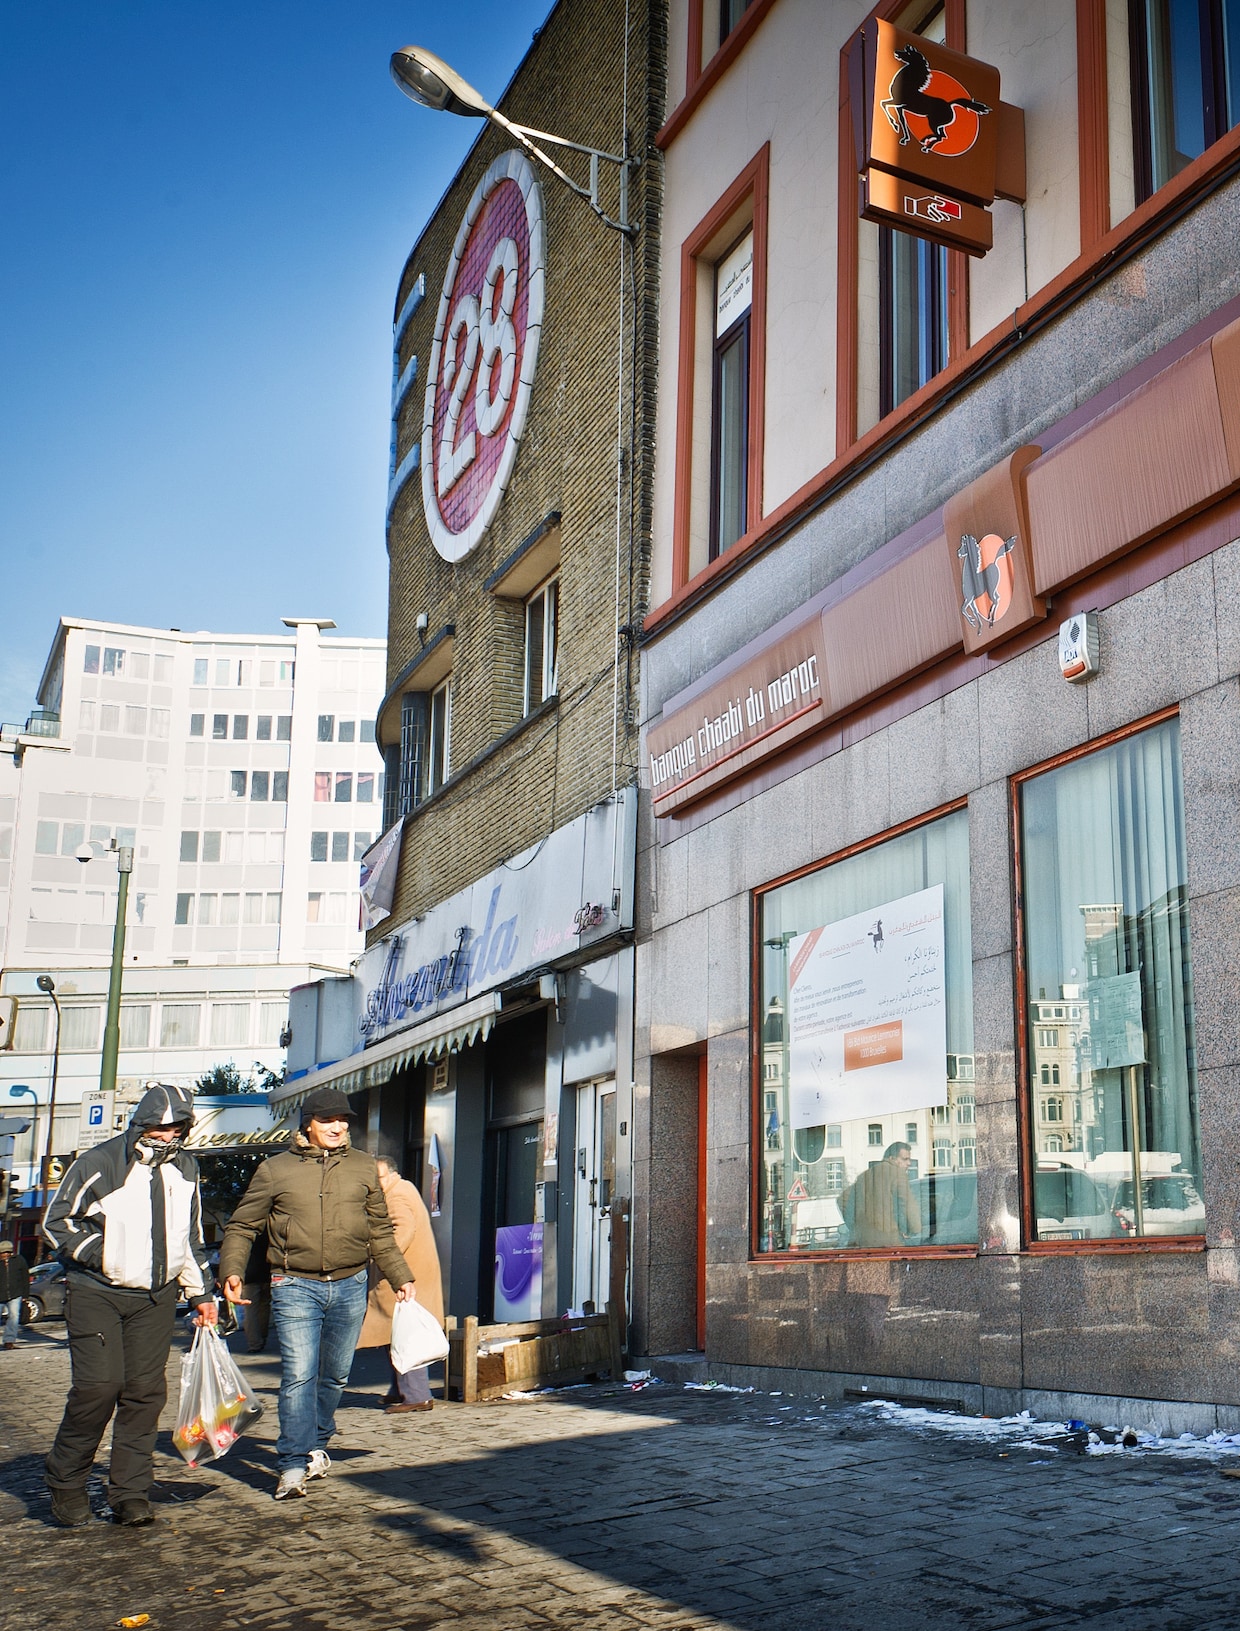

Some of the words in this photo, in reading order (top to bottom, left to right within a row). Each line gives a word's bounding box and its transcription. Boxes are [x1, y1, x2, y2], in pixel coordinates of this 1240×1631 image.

[440, 236, 519, 500] 28
[650, 735, 696, 787] banque
[697, 697, 744, 757] chaabi
[745, 686, 765, 727] du
[767, 654, 820, 713] maroc
[91, 1107, 101, 1123] P
